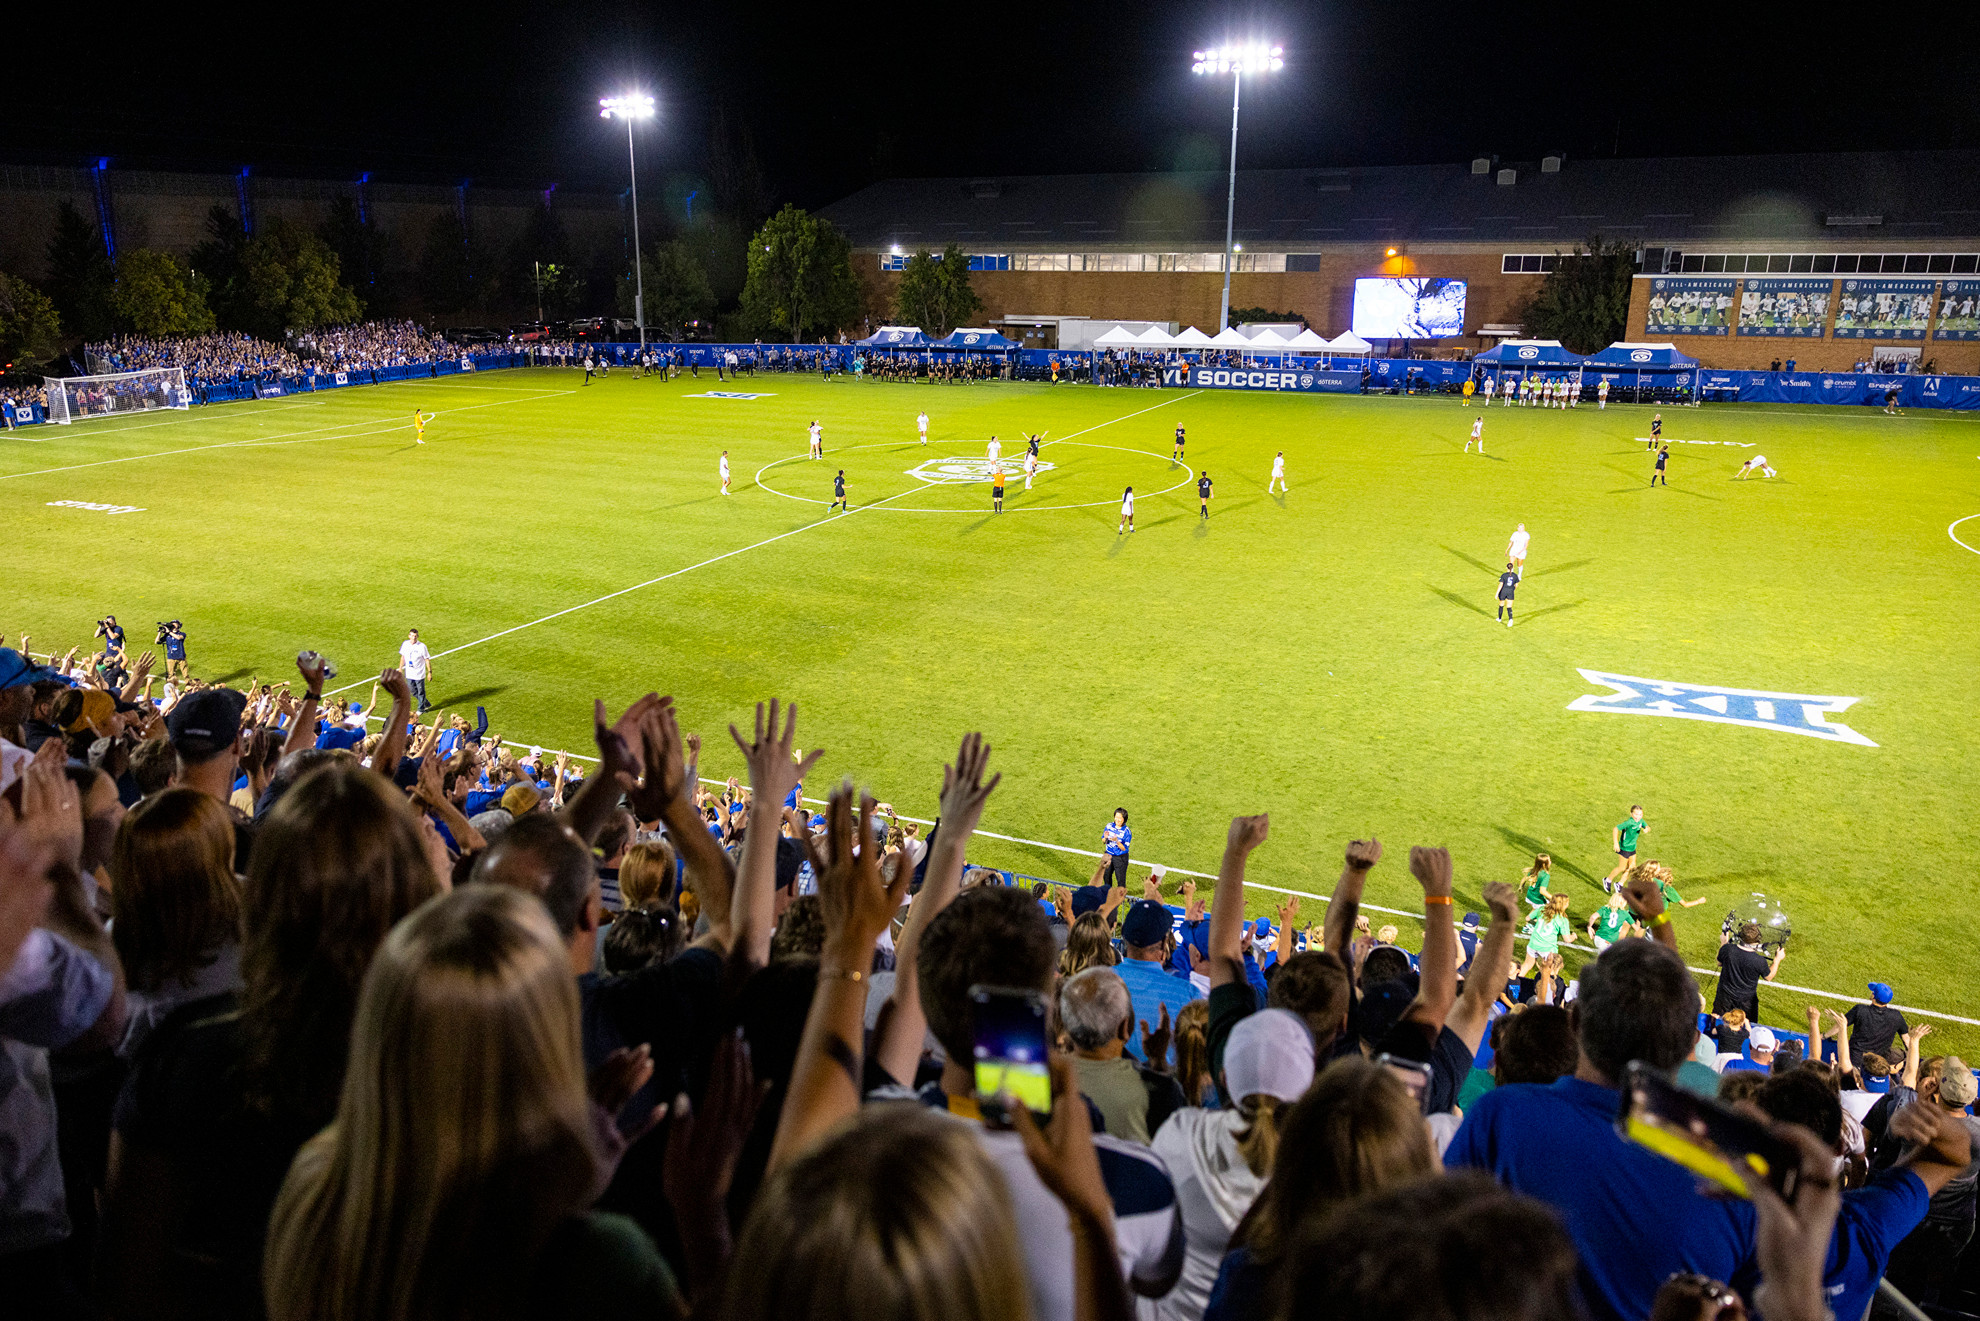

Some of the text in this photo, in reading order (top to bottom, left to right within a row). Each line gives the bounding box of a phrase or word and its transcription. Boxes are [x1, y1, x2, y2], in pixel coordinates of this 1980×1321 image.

[1197, 370, 1298, 388] SOCCER
[1507, 576, 1514, 587] 5
[1588, 674, 1842, 736] XII
[1608, 911, 1619, 928] 8
